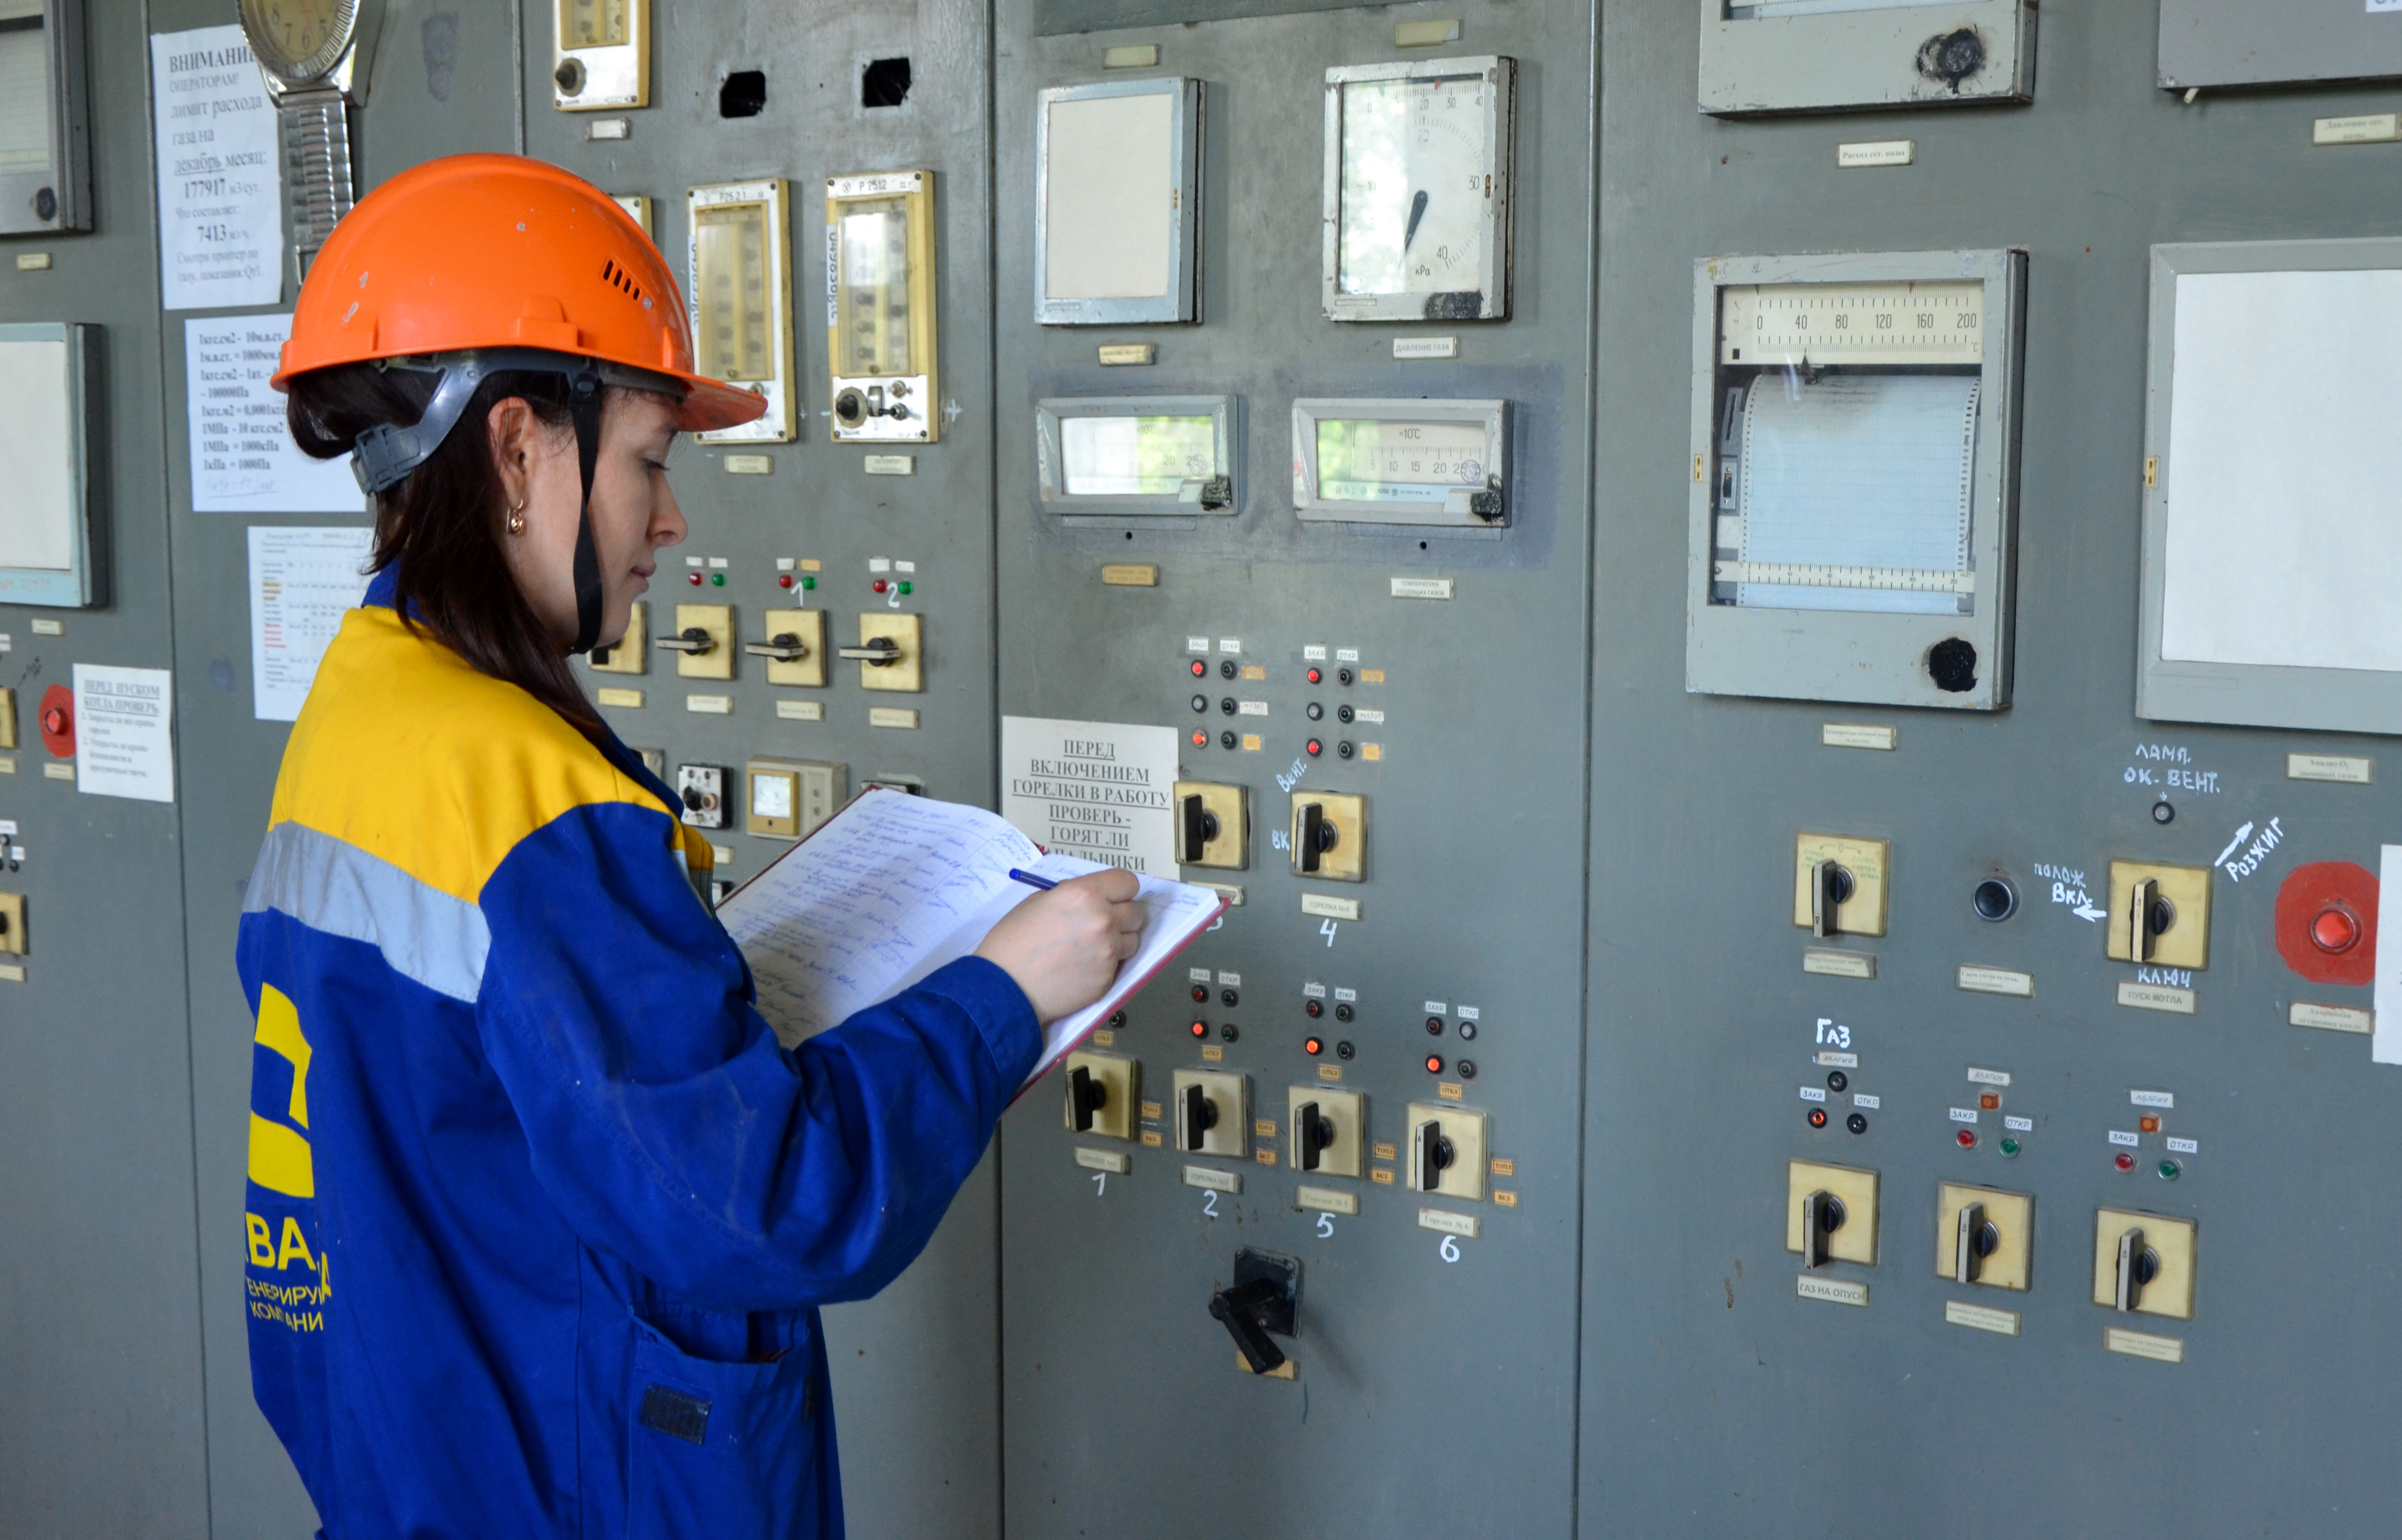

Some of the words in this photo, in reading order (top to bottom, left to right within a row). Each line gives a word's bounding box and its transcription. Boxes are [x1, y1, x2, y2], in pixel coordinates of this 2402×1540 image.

[212, 96, 262, 118] расхода
[1419, 99, 1428, 110] 20
[1446, 97, 1456, 109] 30
[1475, 95, 1483, 107] 40
[2324, 120, 2368, 130] Давление
[172, 131, 196, 145] газа
[198, 129, 214, 141] на
[185, 178, 226, 198] 177917
[1468, 175, 1480, 190] 30
[197, 224, 226, 242] 7413
[1436, 245, 1448, 260] 40
[1756, 315, 1763, 330] 0
[1795, 315, 1808, 330] 40
[1835, 315, 1848, 330] 80
[1875, 314, 1892, 329] 120
[1916, 313, 1934, 328] 160
[1957, 313, 1977, 328] 200
[1395, 343, 1432, 353] ДАВЛЕНИЕ
[1433, 342, 1450, 351] ГАЗА
[1163, 455, 1175, 466] 20
[1371, 460, 1375, 470] 5
[1389, 461, 1398, 471] 10
[1411, 461, 1420, 472] 15
[1433, 463, 1447, 473] 20
[790, 582, 803, 607] 1
[887, 582, 900, 608] 2
[116, 682, 160, 698] ПУСКОМ
[1064, 739, 1115, 759] ПЕРЕД
[1031, 758, 1150, 782] ВКЛЮЧЕНИЕМ
[2309, 759, 2338, 767] Анализ
[2167, 768, 2220, 794] ВЕНТ.
[1012, 779, 1085, 799] ГОРЕЛКИ
[1090, 786, 1100, 800] В
[1104, 787, 1170, 806] РАБОТУ
[1049, 804, 1122, 824] ПРОВЕРЬ
[1050, 826, 1102, 844] ГОРЯТ
[1105, 833, 1129, 847] ЛИ
[2225, 816, 2284, 883] РОЗЖИГ
[1309, 901, 1337, 911] ГОРЕЛКА
[1338, 905, 1350, 913] №4
[1320, 918, 1337, 947] 4
[2138, 967, 2191, 988] КЛЮЧ
[2128, 990, 2151, 1003] ПУСК
[2152, 993, 2182, 1006] КОТЛА
[2309, 1008, 2352, 1019] Аварийная
[2299, 1018, 2337, 1027] остановка
[1824, 1055, 1853, 1065] АВАРИЯ
[1974, 1071, 2004, 1083] АВАРИЯ
[1802, 1090, 1823, 1099] ЗАКР
[1857, 1097, 1878, 1106] ОТКР
[2136, 1094, 2168, 1104] АВАРИЯ
[1951, 1110, 1974, 1120] ЗАКР
[2006, 1118, 2029, 1129] ОТКР
[2111, 1133, 2135, 1143] ЗАКР
[2170, 1140, 2194, 1150] ОТКР
[1376, 1148, 1393, 1156] ТОПЛ
[1495, 1162, 1511, 1171] ТОПЛ
[1092, 1172, 1106, 1196] 1
[1191, 1173, 1217, 1184] ГОРЕЛКА
[1203, 1190, 1218, 1217] 2
[1305, 1194, 1332, 1206] Горелка
[1498, 1194, 1510, 1202] ВКЛ
[1316, 1212, 1336, 1238] 5
[1424, 1215, 1452, 1227] Горелка
[1440, 1235, 1460, 1262] 6
[246, 1276, 324, 1306] ЕНЕРИРУ
[1799, 1283, 1816, 1294] ГАЗ
[1817, 1285, 1831, 1296] НА
